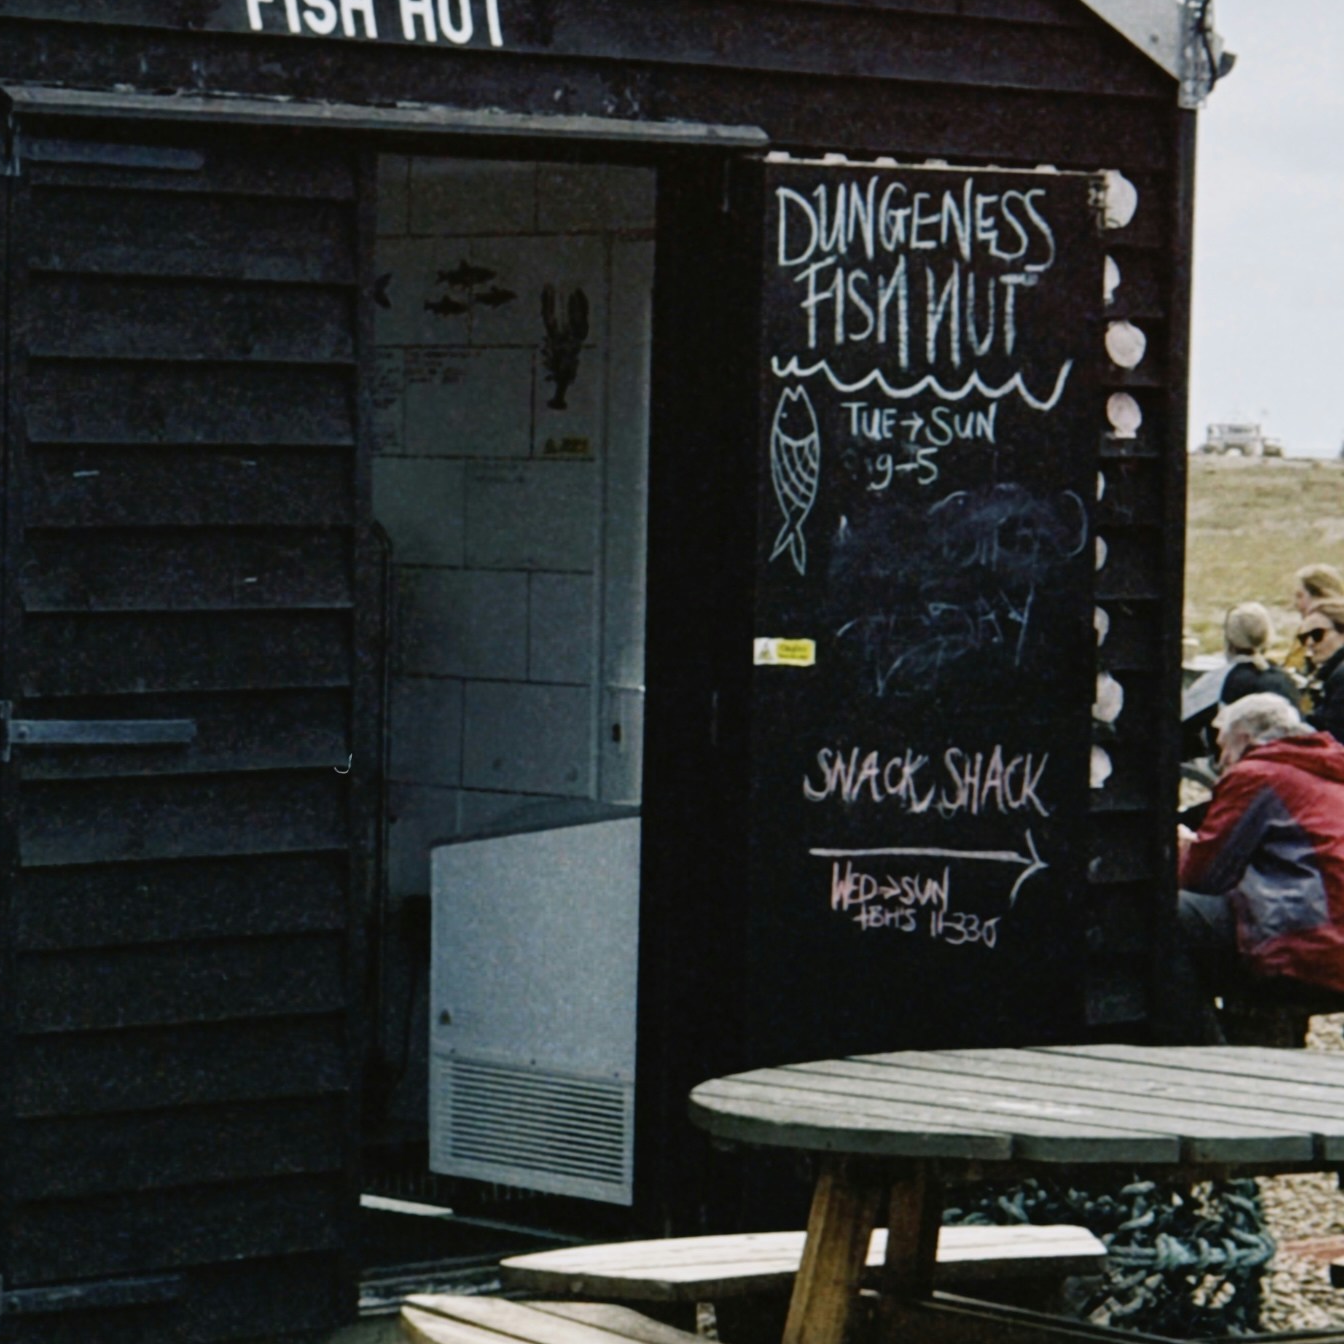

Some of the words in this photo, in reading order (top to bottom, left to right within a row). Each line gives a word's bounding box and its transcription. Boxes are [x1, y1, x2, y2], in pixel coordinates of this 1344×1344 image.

[775, 177, 1056, 271] DUNGENESS
[794, 254, 909, 369] FISH
[926, 261, 1038, 367] HUT
[840, 402, 896, 440] TUE
[927, 403, 997, 445] SUN
[803, 747, 935, 813] SNACK
[941, 745, 1049, 817] SHACK
[831, 861, 878, 910] WED
[900, 866, 950, 914] SUN
